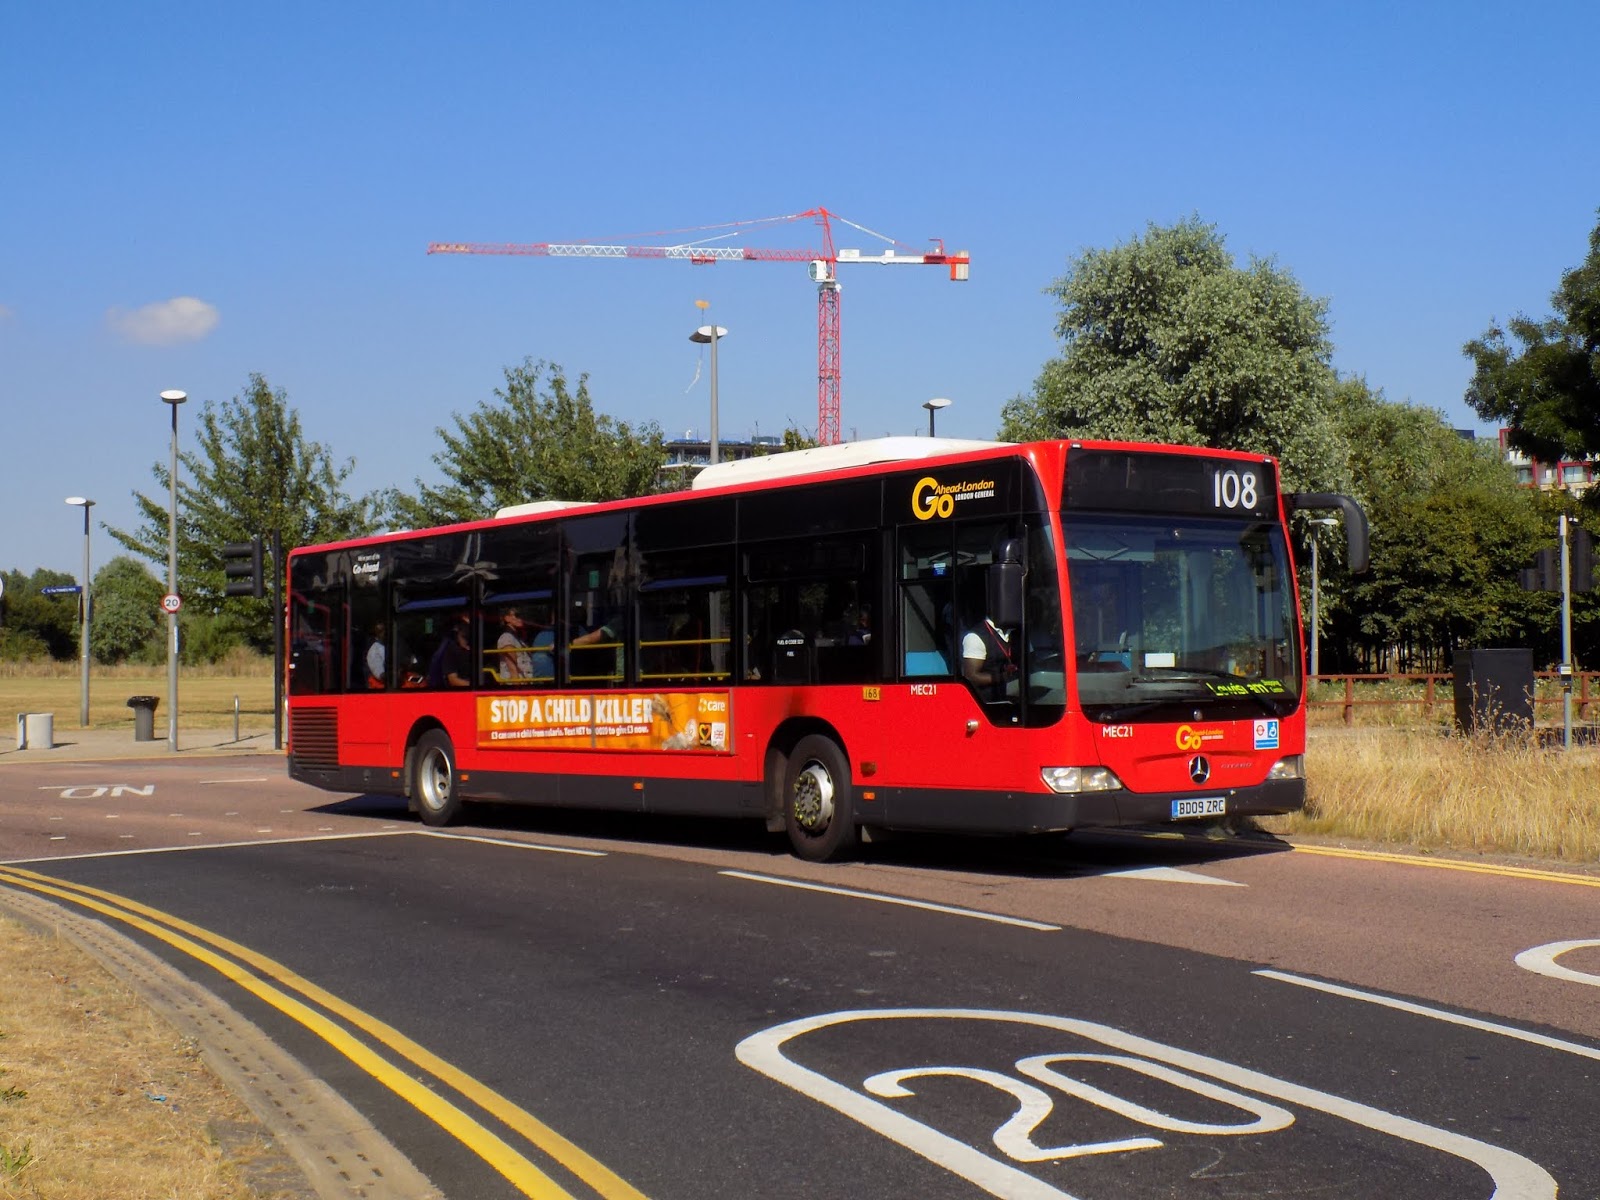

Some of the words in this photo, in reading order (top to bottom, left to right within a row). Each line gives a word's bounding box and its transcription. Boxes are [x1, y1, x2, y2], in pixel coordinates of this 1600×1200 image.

[955, 493, 974, 501] LONDON
[974, 490, 995, 499] GENERAL
[1214, 469, 1257, 509] 108
[912, 477, 954, 520] Go
[165, 599, 179, 607] 20
[864, 688, 878, 698] 168
[910, 684, 937, 695] MEC21
[1206, 682, 1269, 696] Lewisam
[491, 699, 528, 723] STOP
[530, 699, 543, 723] A
[545, 699, 591, 723] CHILD
[596, 698, 653, 723] KILLER
[707, 700, 725, 711] care
[1102, 726, 1133, 738] MEC21
[1176, 725, 1201, 750] Go
[1178, 801, 1204, 815] BD09
[1206, 799, 1224, 813] ZRC
[863, 1053, 1295, 1162] 20
